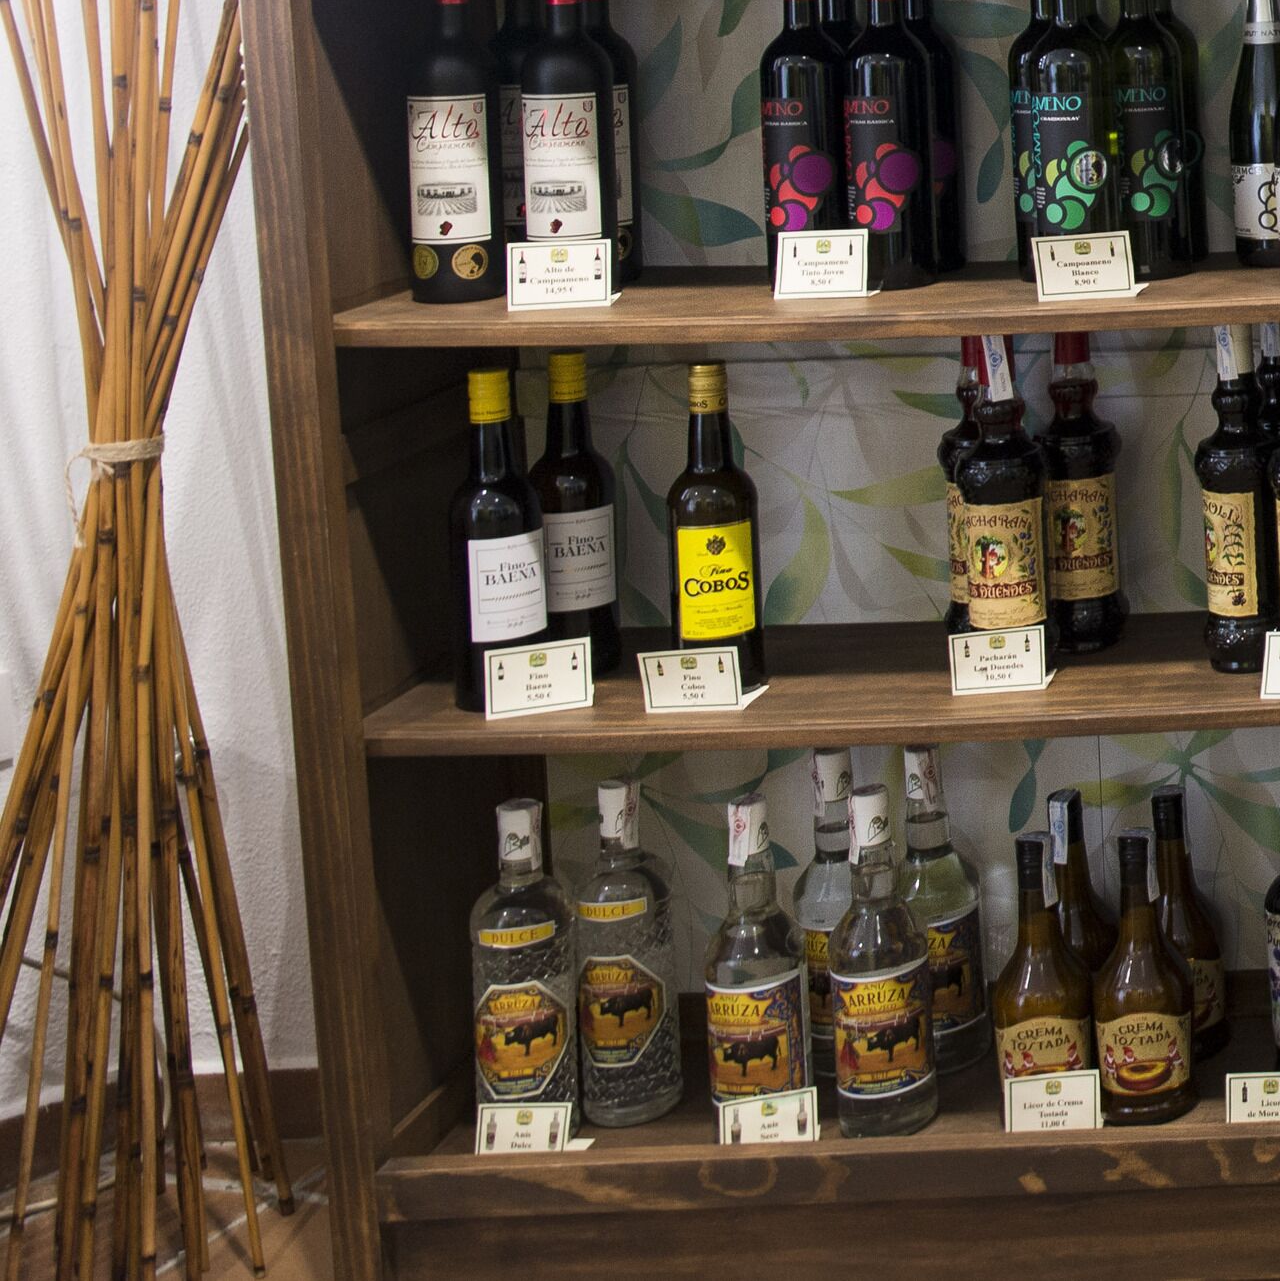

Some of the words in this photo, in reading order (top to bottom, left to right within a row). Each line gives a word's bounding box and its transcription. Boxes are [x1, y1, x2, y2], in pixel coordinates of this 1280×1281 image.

[412, 103, 480, 140] Alto
[525, 103, 591, 140] Alto
[416, 135, 475, 153] Campoameno
[530, 135, 585, 151] Campoameno
[797, 258, 849, 269] Campoameno
[1056, 258, 1112, 270] Campoameno
[544, 266, 562, 274] Alto
[821, 269, 845, 278] Joven
[1070, 268, 1099, 277] Blanco
[529, 276, 589, 286] Campoameno
[1074, 278, 1091, 287] 8,90
[545, 286, 567, 295] 14,95
[1046, 490, 1106, 504] ACHARAN
[965, 515, 1029, 529] ACHARAN
[568, 535, 594, 545] Fino
[554, 541, 606, 558] BAENA
[500, 561, 525, 572] Fino
[484, 567, 536, 586] BAENA
[684, 571, 750, 597] COBOS
[978, 652, 1017, 663] Pacharán
[991, 661, 1024, 672] Duendes
[529, 672, 549, 680] Fino
[683, 674, 702, 682] Fino
[985, 673, 1008, 681] 10,50
[525, 681, 553, 691] Baena
[680, 683, 706, 691] Cobos
[527, 692, 545, 702] 5,50
[683, 692, 700, 700] 5,50
[586, 902, 631, 917] DULCE
[491, 929, 538, 943] DULCE
[589, 972, 628, 983] ARRUZA
[849, 988, 905, 1007] ARRUZA
[493, 999, 536, 1011] ARRUZA
[710, 1003, 761, 1017] ARRUZA
[1017, 1026, 1062, 1040] CREMA
[1118, 1021, 1163, 1036] CREMA
[1011, 1034, 1070, 1052] TOSTADA
[1112, 1030, 1170, 1046] TOSTADA
[1023, 1101, 1044, 1110] Licor
[1057, 1099, 1084, 1107] Crema
[1261, 1099, 1280, 1107] Licor
[1039, 1109, 1069, 1119] Tostada
[760, 1131, 780, 1140] Seco
[510, 1141, 533, 1149] Dulce
